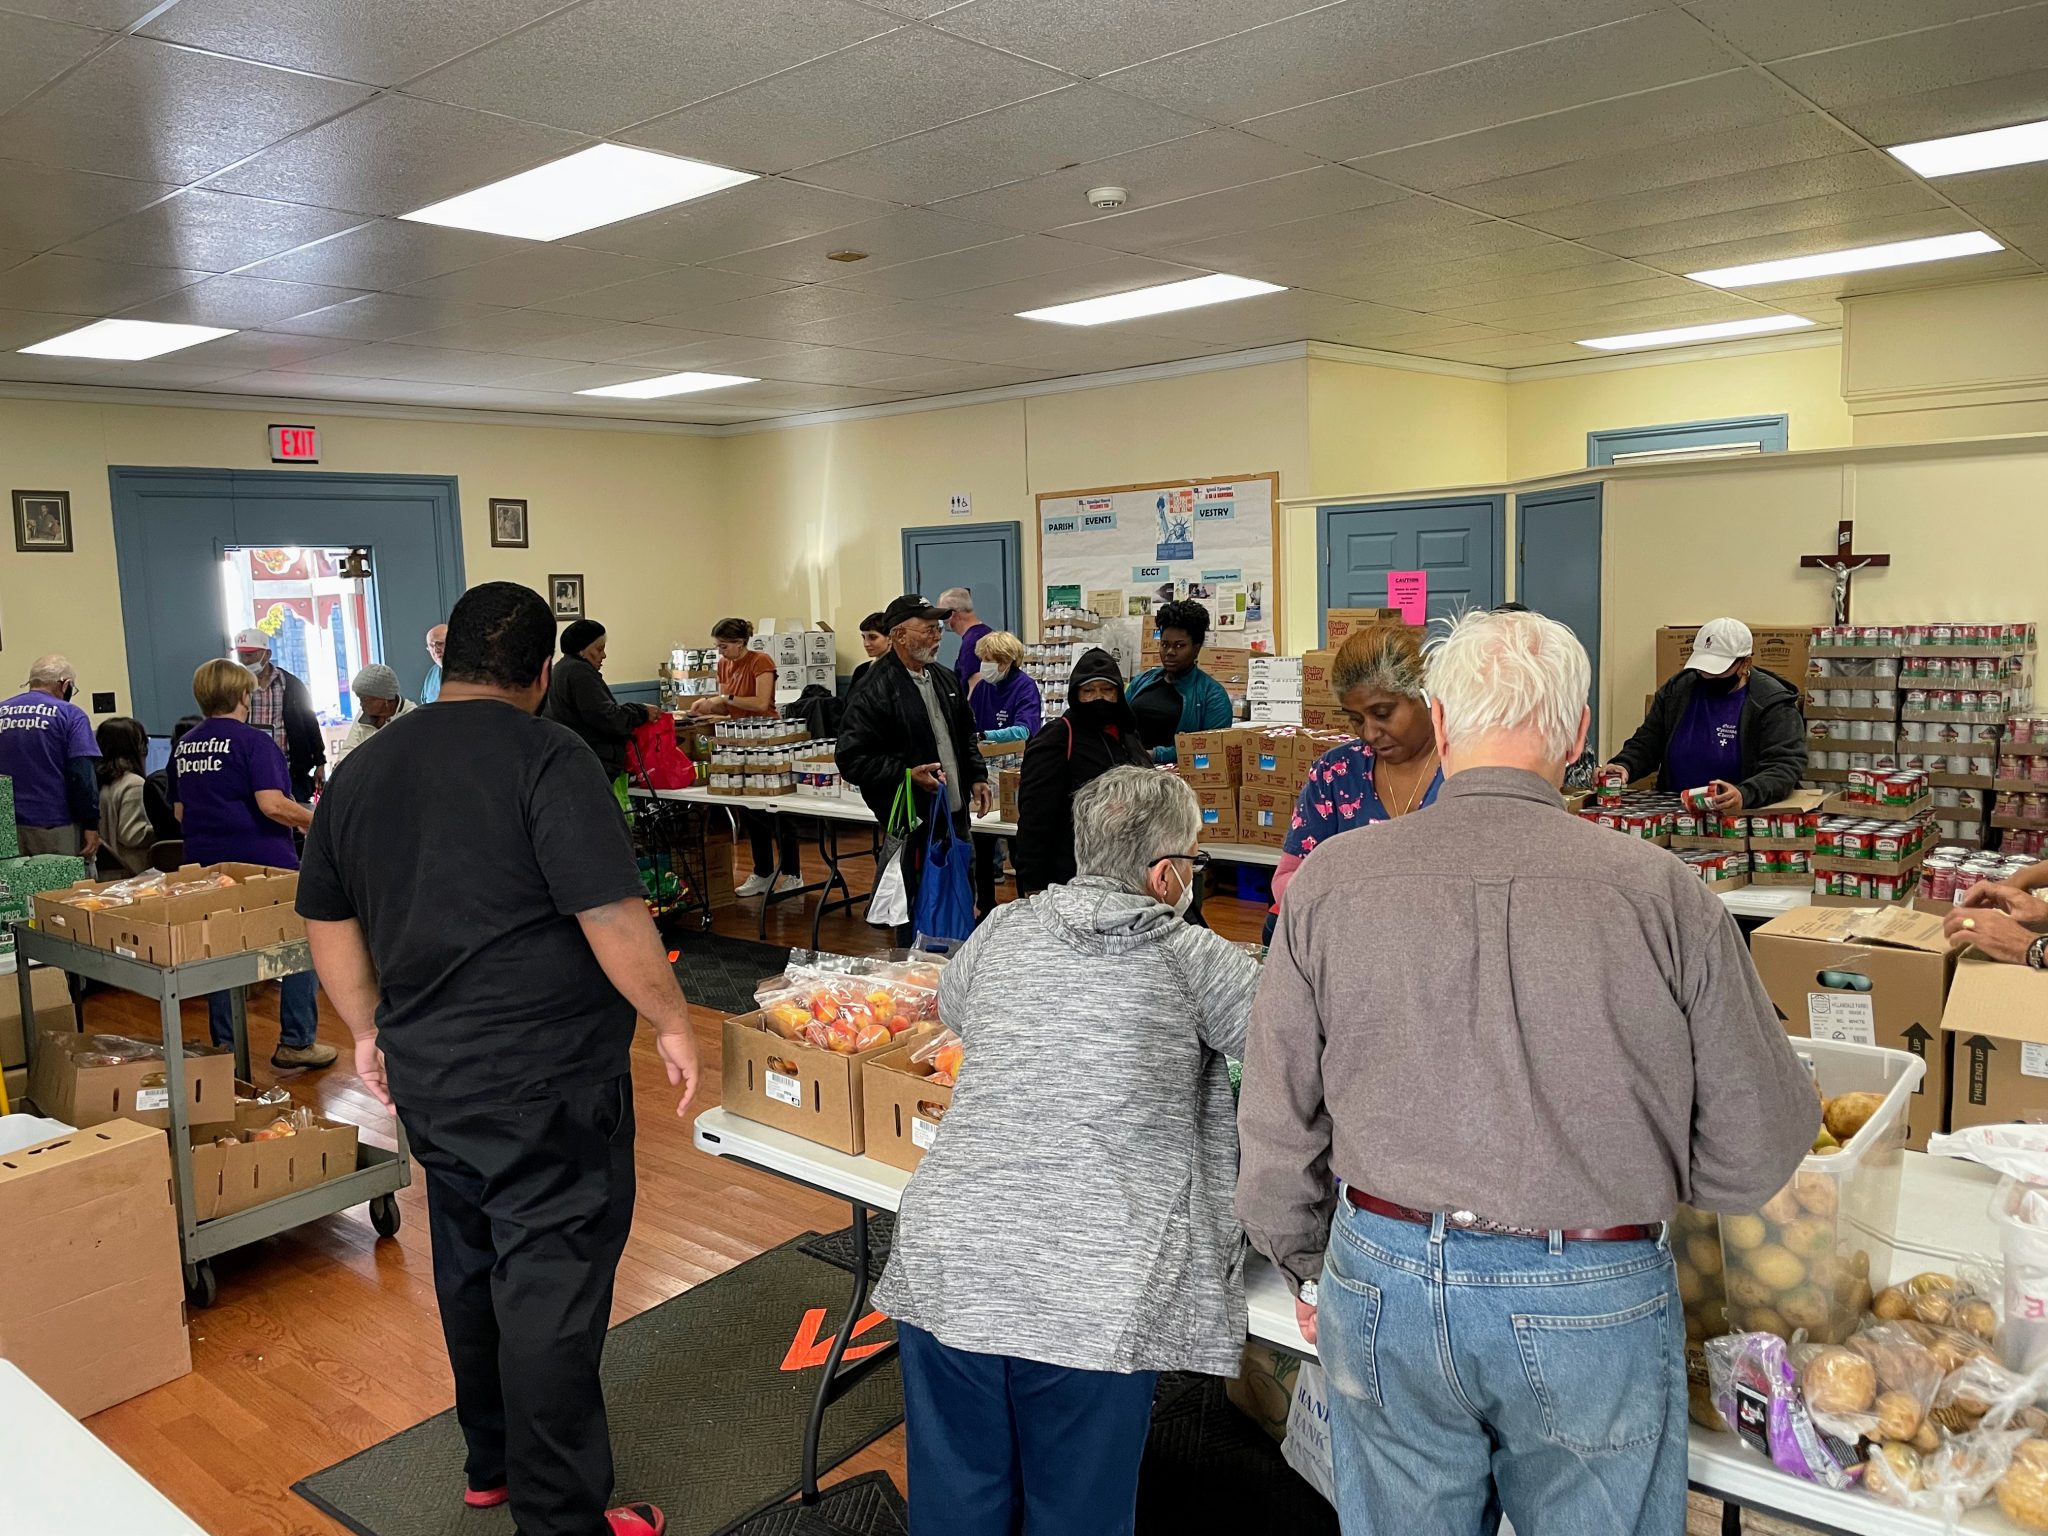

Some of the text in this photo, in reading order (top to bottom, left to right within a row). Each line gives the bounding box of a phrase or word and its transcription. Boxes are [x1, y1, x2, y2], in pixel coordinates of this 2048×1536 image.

[281, 429, 314, 457] EXIT
[1200, 508, 1229, 518] VESTRY
[1048, 516, 1112, 532] PARISH EVENTS
[1141, 568, 1160, 576] ECCT
[1328, 620, 1350, 630] Dairy
[1329, 627, 1348, 636] Pure
[1303, 666, 1325, 676] Dairy
[1304, 672, 1323, 681] Pure
[0, 704, 58, 717] Graceful
[1303, 710, 1325, 720] Dairy
[0, 716, 50, 733] People
[174, 737, 232, 758] Graceful
[176, 756, 222, 778] People
[1242, 829, 1250, 838] 12
[1913, 1038, 1921, 1051] UP
[1974, 1048, 1985, 1102] THIS END UP
